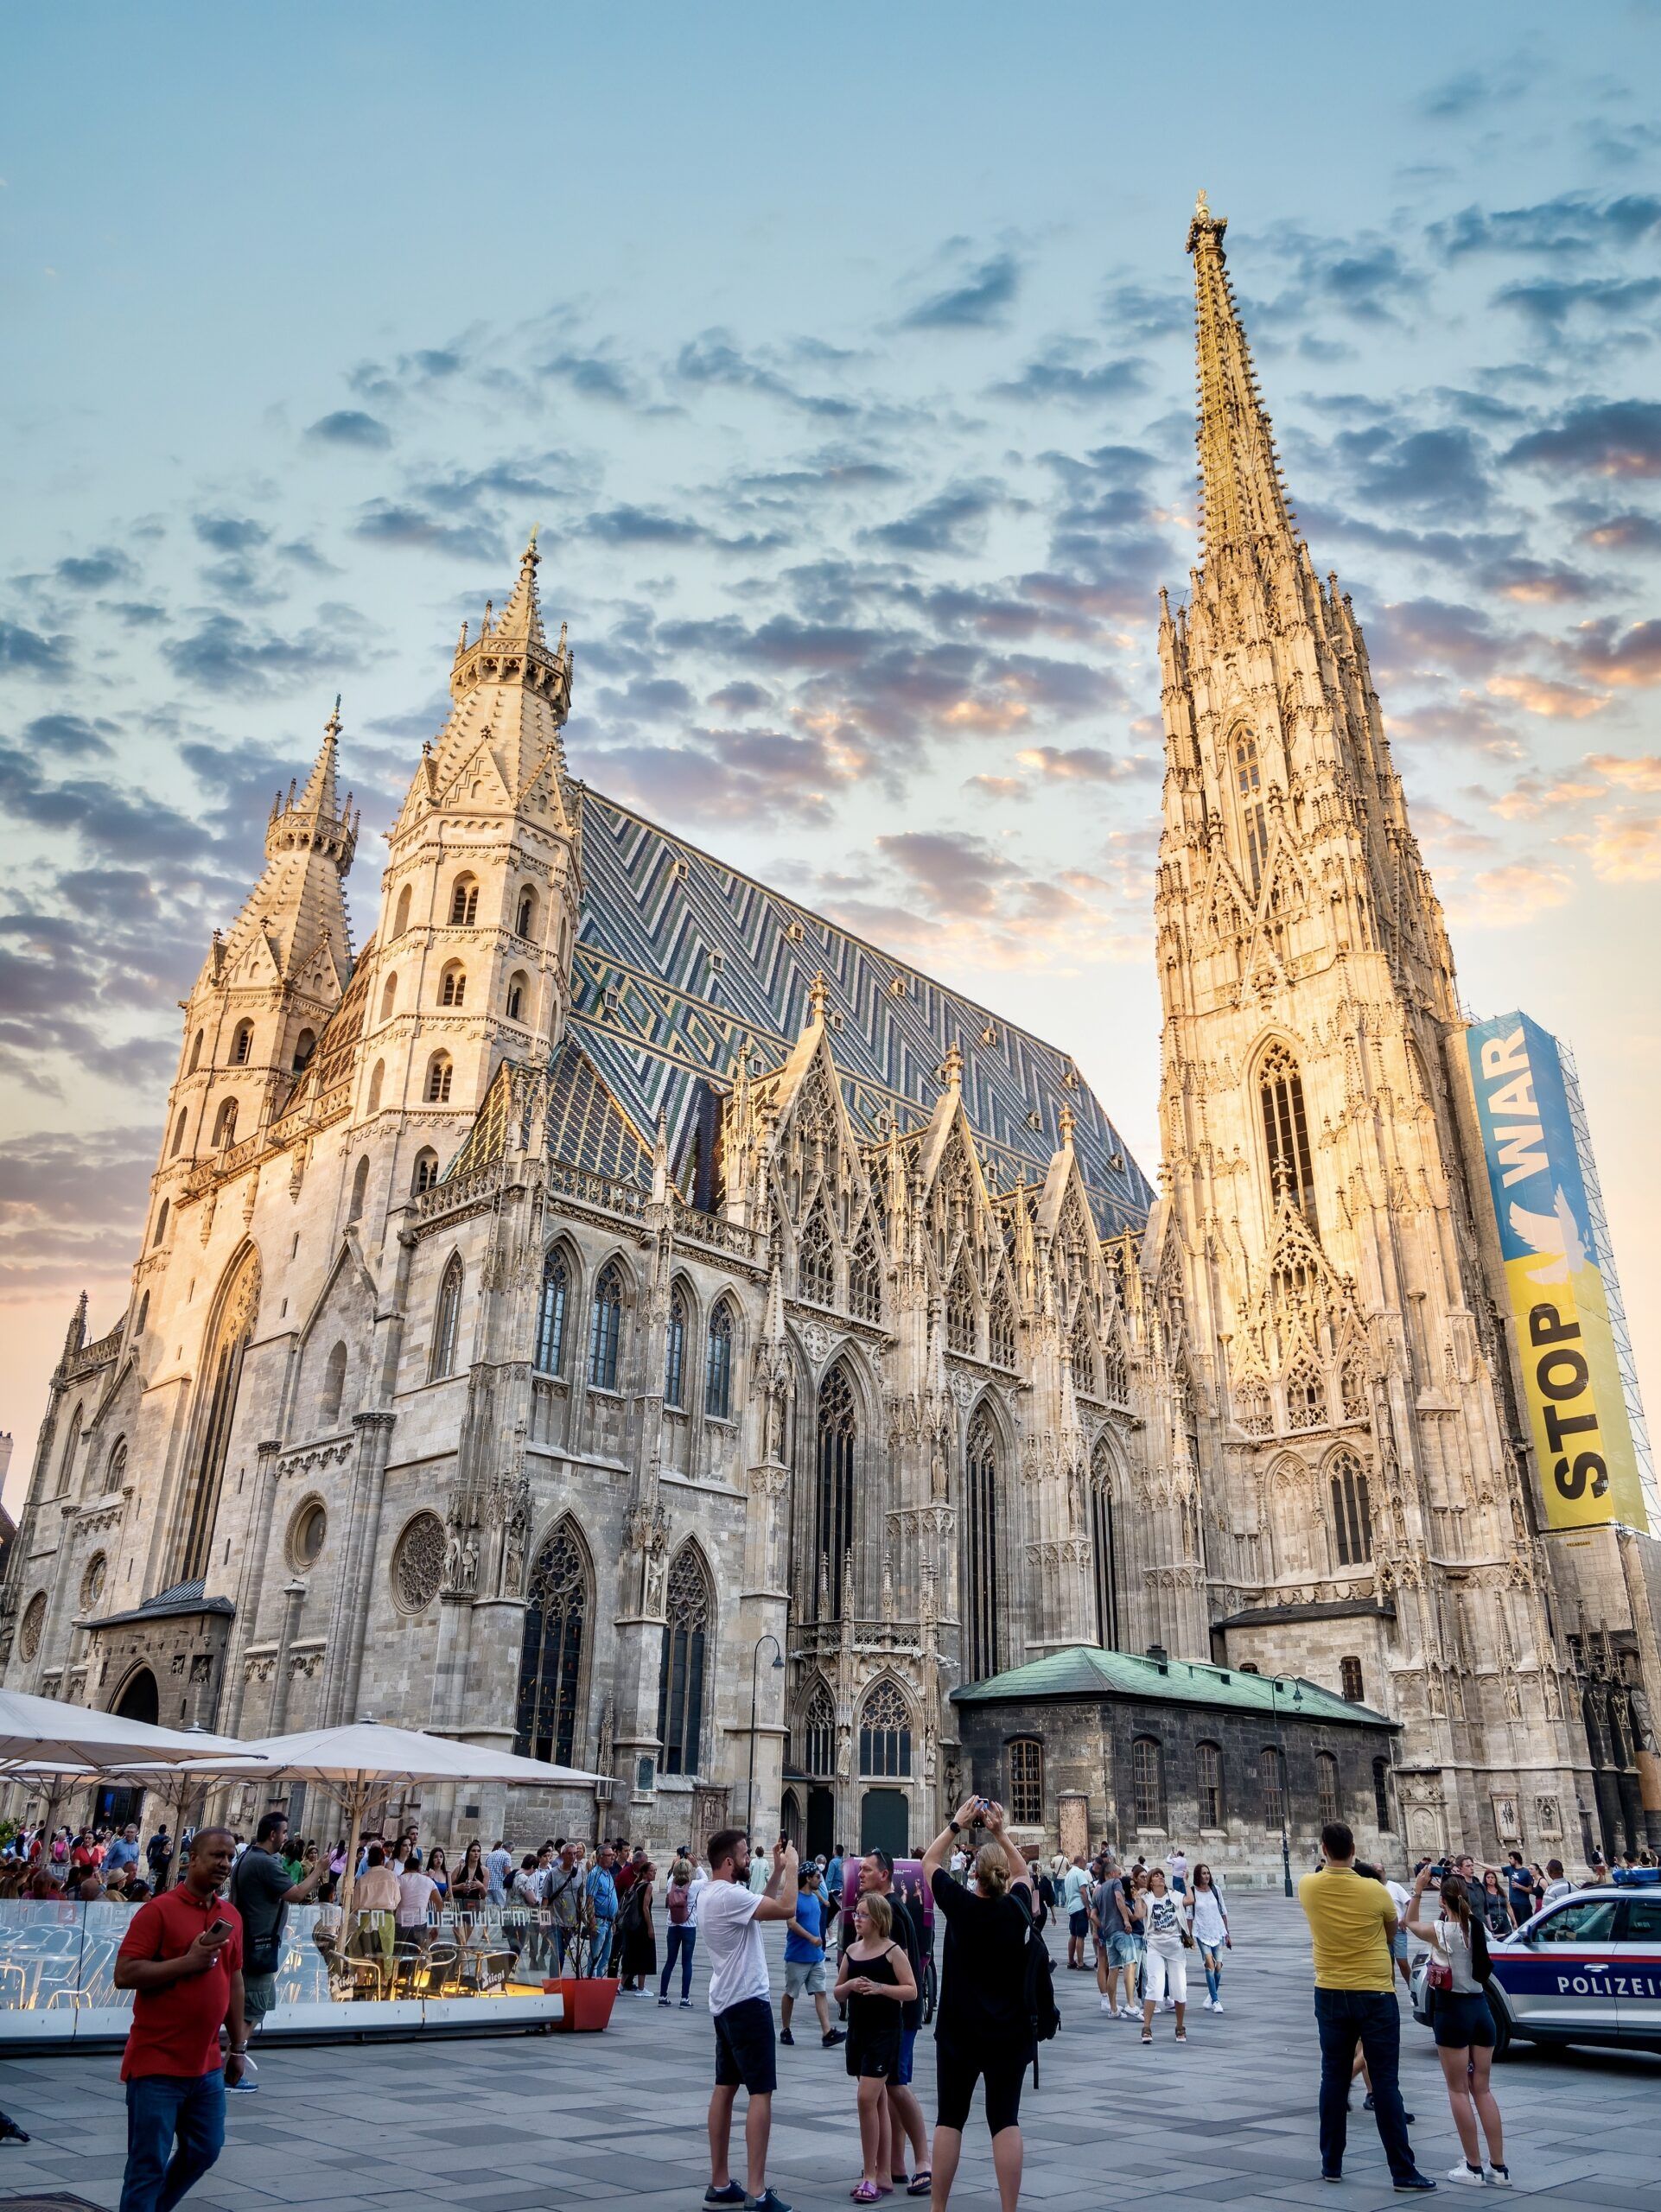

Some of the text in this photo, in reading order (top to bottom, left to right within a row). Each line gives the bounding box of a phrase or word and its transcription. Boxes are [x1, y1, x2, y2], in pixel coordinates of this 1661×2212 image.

[1480, 1026, 1550, 1189] WAR
[1529, 1303, 1609, 1500] STOP
[481, 1968, 505, 1989] Stiegl
[1556, 1976, 1656, 1996] POLIZEI
